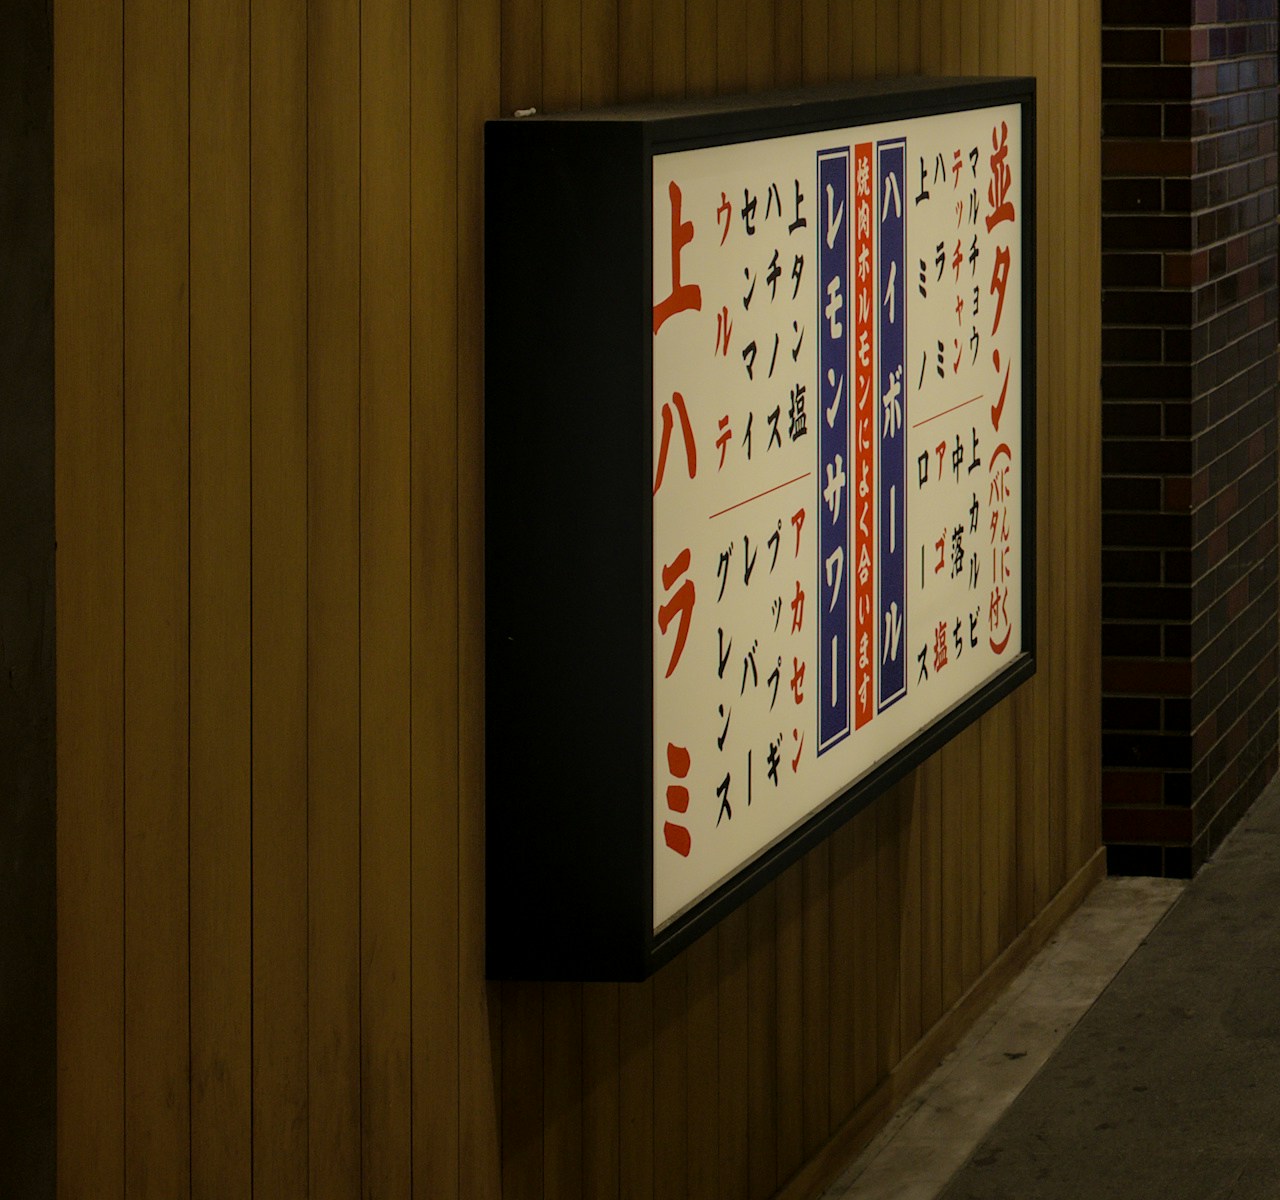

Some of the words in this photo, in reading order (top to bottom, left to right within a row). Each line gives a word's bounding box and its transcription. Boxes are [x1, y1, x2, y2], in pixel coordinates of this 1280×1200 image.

[715, 191, 733, 473] ウルテ
[741, 187, 759, 461] センマイ
[764, 182, 783, 453] ハチノス
[788, 178, 808, 443] 上タン塩
[915, 155, 930, 391] 上ミノ
[933, 152, 946, 379] ハラミ
[951, 148, 963, 374] テッチャン
[968, 146, 981, 367] マルチョウ
[985, 120, 1015, 432] 並タン
[653, 180, 702, 858] 上ハラミ
[823, 183, 846, 708] レモンサワー
[856, 155, 872, 714] 焼肉ホルモンによく合います
[882, 171, 903, 666] ハイボール
[950, 433, 965, 660] 中落ち
[967, 426, 981, 649] 上カルビ
[716, 541, 734, 829] グレンス
[740, 535, 759, 807] レバー
[766, 518, 783, 787] プップギ
[790, 507, 806, 774] アカセン
[916, 449, 930, 687] ロース
[933, 439, 948, 674] アゴ塩
